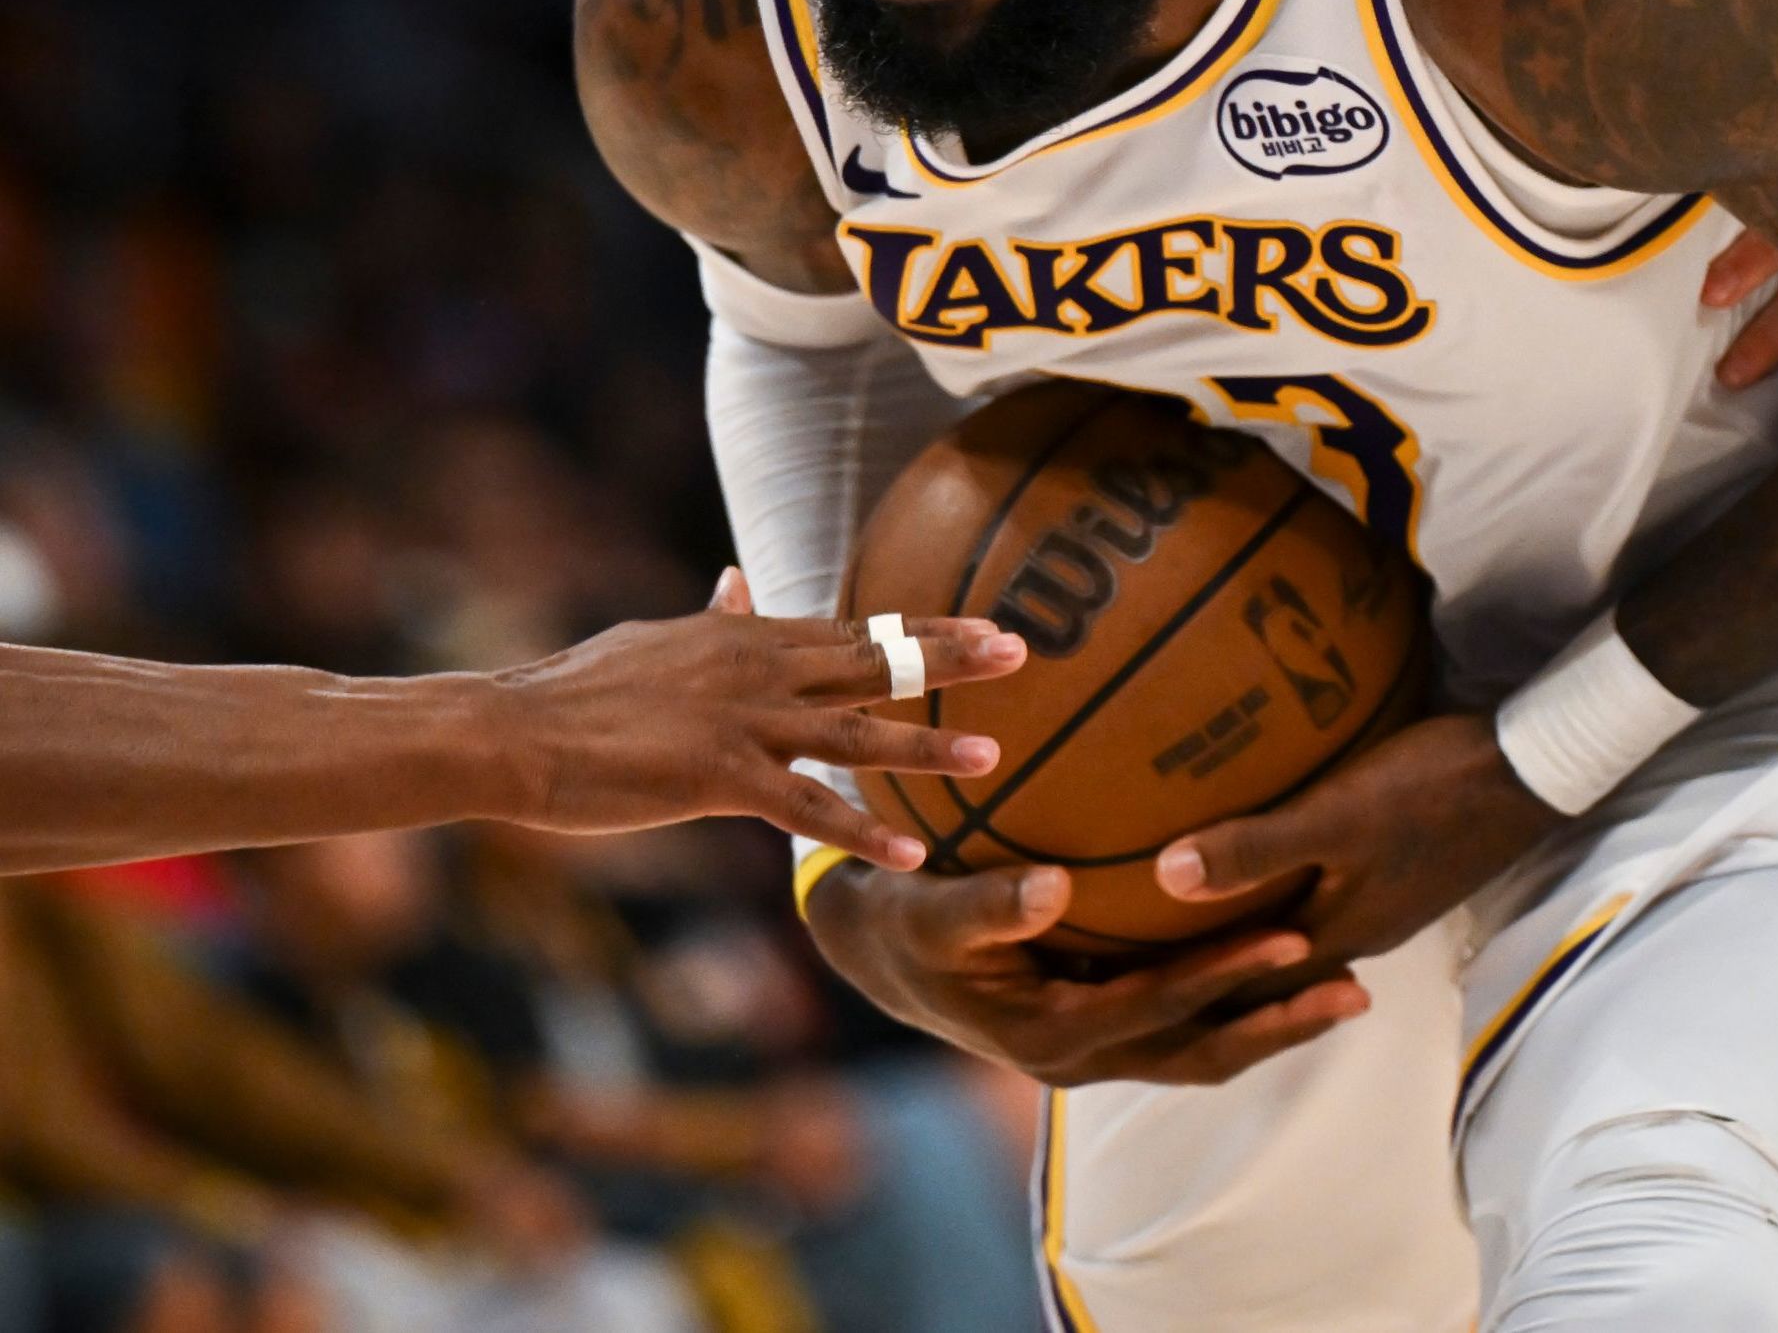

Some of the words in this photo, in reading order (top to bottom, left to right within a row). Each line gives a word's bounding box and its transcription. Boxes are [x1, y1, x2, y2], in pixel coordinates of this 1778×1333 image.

[1228, 100, 1376, 144] bibigo
[1261, 137, 1328, 159] 비비고
[836, 214, 1436, 353] LAKERS
